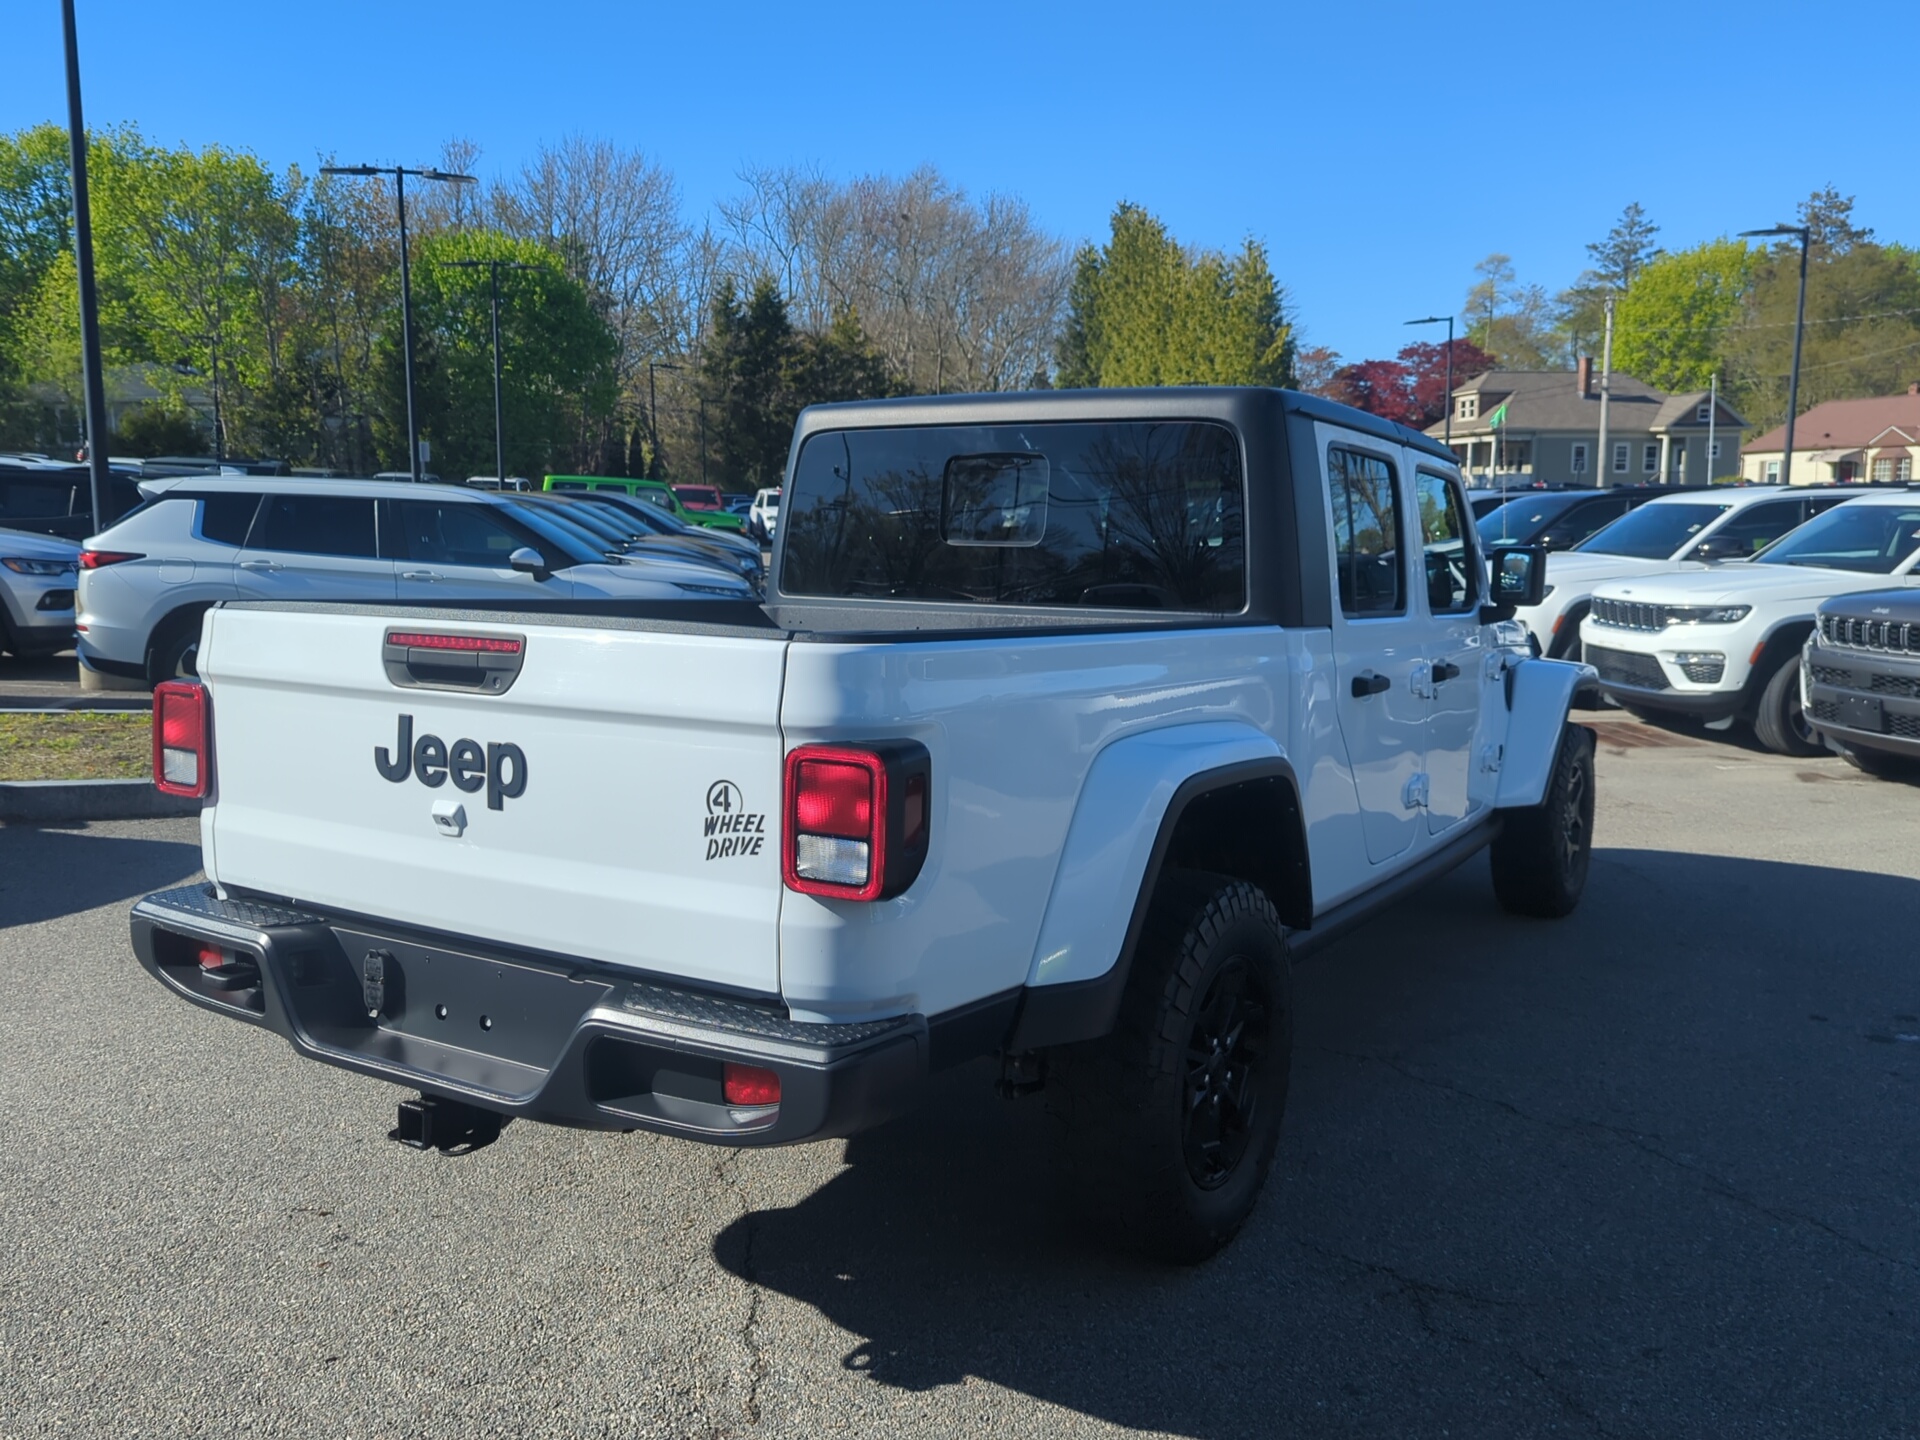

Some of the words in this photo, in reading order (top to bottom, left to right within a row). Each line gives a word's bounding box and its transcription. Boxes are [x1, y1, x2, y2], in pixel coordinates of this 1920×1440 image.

[375, 713, 528, 811] Jeep
[712, 785, 732, 813] 4
[704, 814, 765, 837] WHEEL
[705, 836, 765, 861] DRIVE
